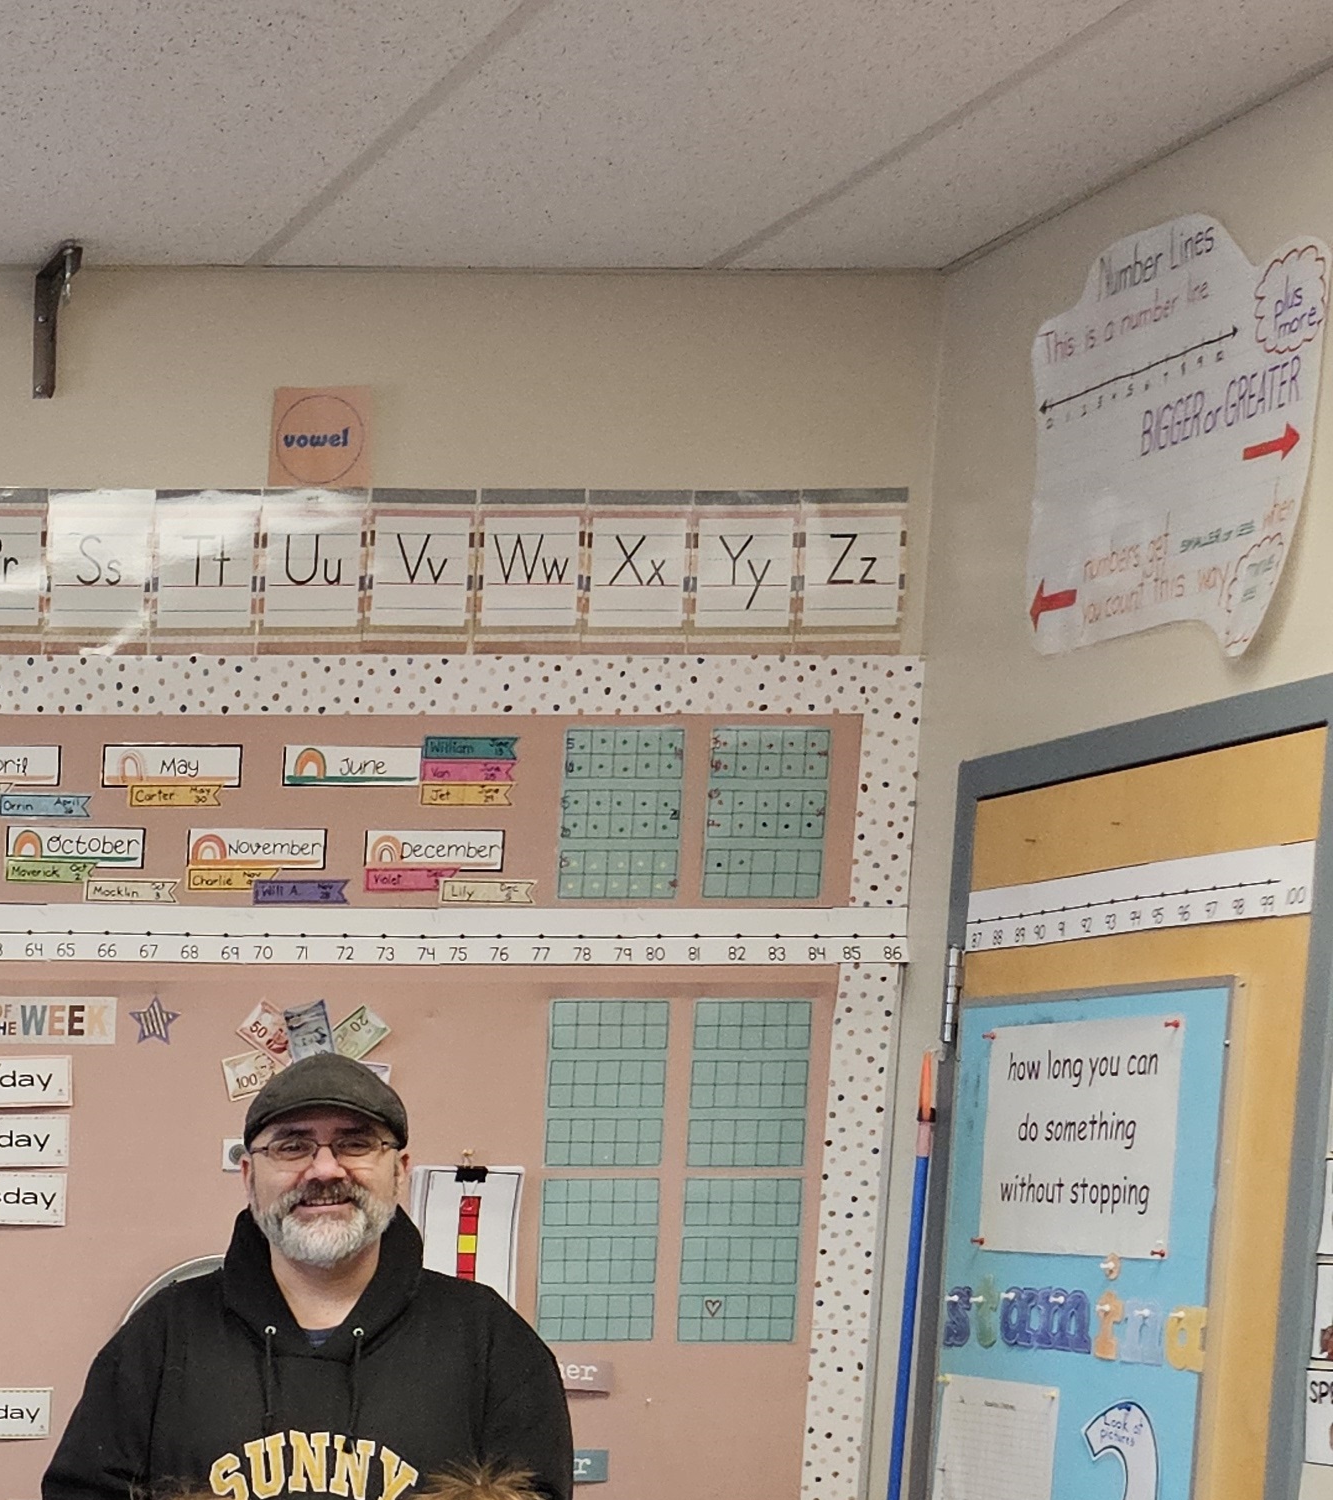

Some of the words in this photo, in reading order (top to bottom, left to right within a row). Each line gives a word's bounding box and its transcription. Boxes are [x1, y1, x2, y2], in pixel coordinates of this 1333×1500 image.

[1098, 243, 1163, 300] Number
[1170, 224, 1216, 270] Lines
[1275, 274, 1303, 317] plus
[1041, 328, 1075, 365] This
[1084, 324, 1097, 350] is
[1119, 288, 1179, 336] number
[1277, 306, 1318, 340] more
[1141, 390, 1206, 457] BIGGER
[1204, 406, 1221, 432] or
[1225, 355, 1301, 426] GREATER
[283, 428, 349, 449] vowel
[76, 536, 122, 586] Ss
[182, 535, 231, 586] Tt
[285, 534, 342, 585] Uu
[397, 534, 448, 584] Vv
[494, 534, 569, 584] Ww
[609, 535, 665, 586] Xx
[719, 535, 771, 610] Yy
[827, 534, 877, 584] Zz
[160, 759, 199, 777] May
[340, 758, 387, 775] June
[136, 789, 174, 803] Carter
[47, 835, 140, 855] October
[229, 842, 322, 858] November
[401, 842, 501, 860] December
[20, 1004, 107, 1037] WEEK
[1007, 1053, 1040, 1082] how
[1047, 1049, 1083, 1088] long
[1089, 1056, 1120, 1087] you
[1127, 1051, 1158, 1077] can
[1018, 1112, 1038, 1143] do
[1045, 1112, 1137, 1149] something
[1000, 1175, 1064, 1205] without
[1070, 1176, 1150, 1215] stopping
[943, 1253, 1206, 1373] stamina
